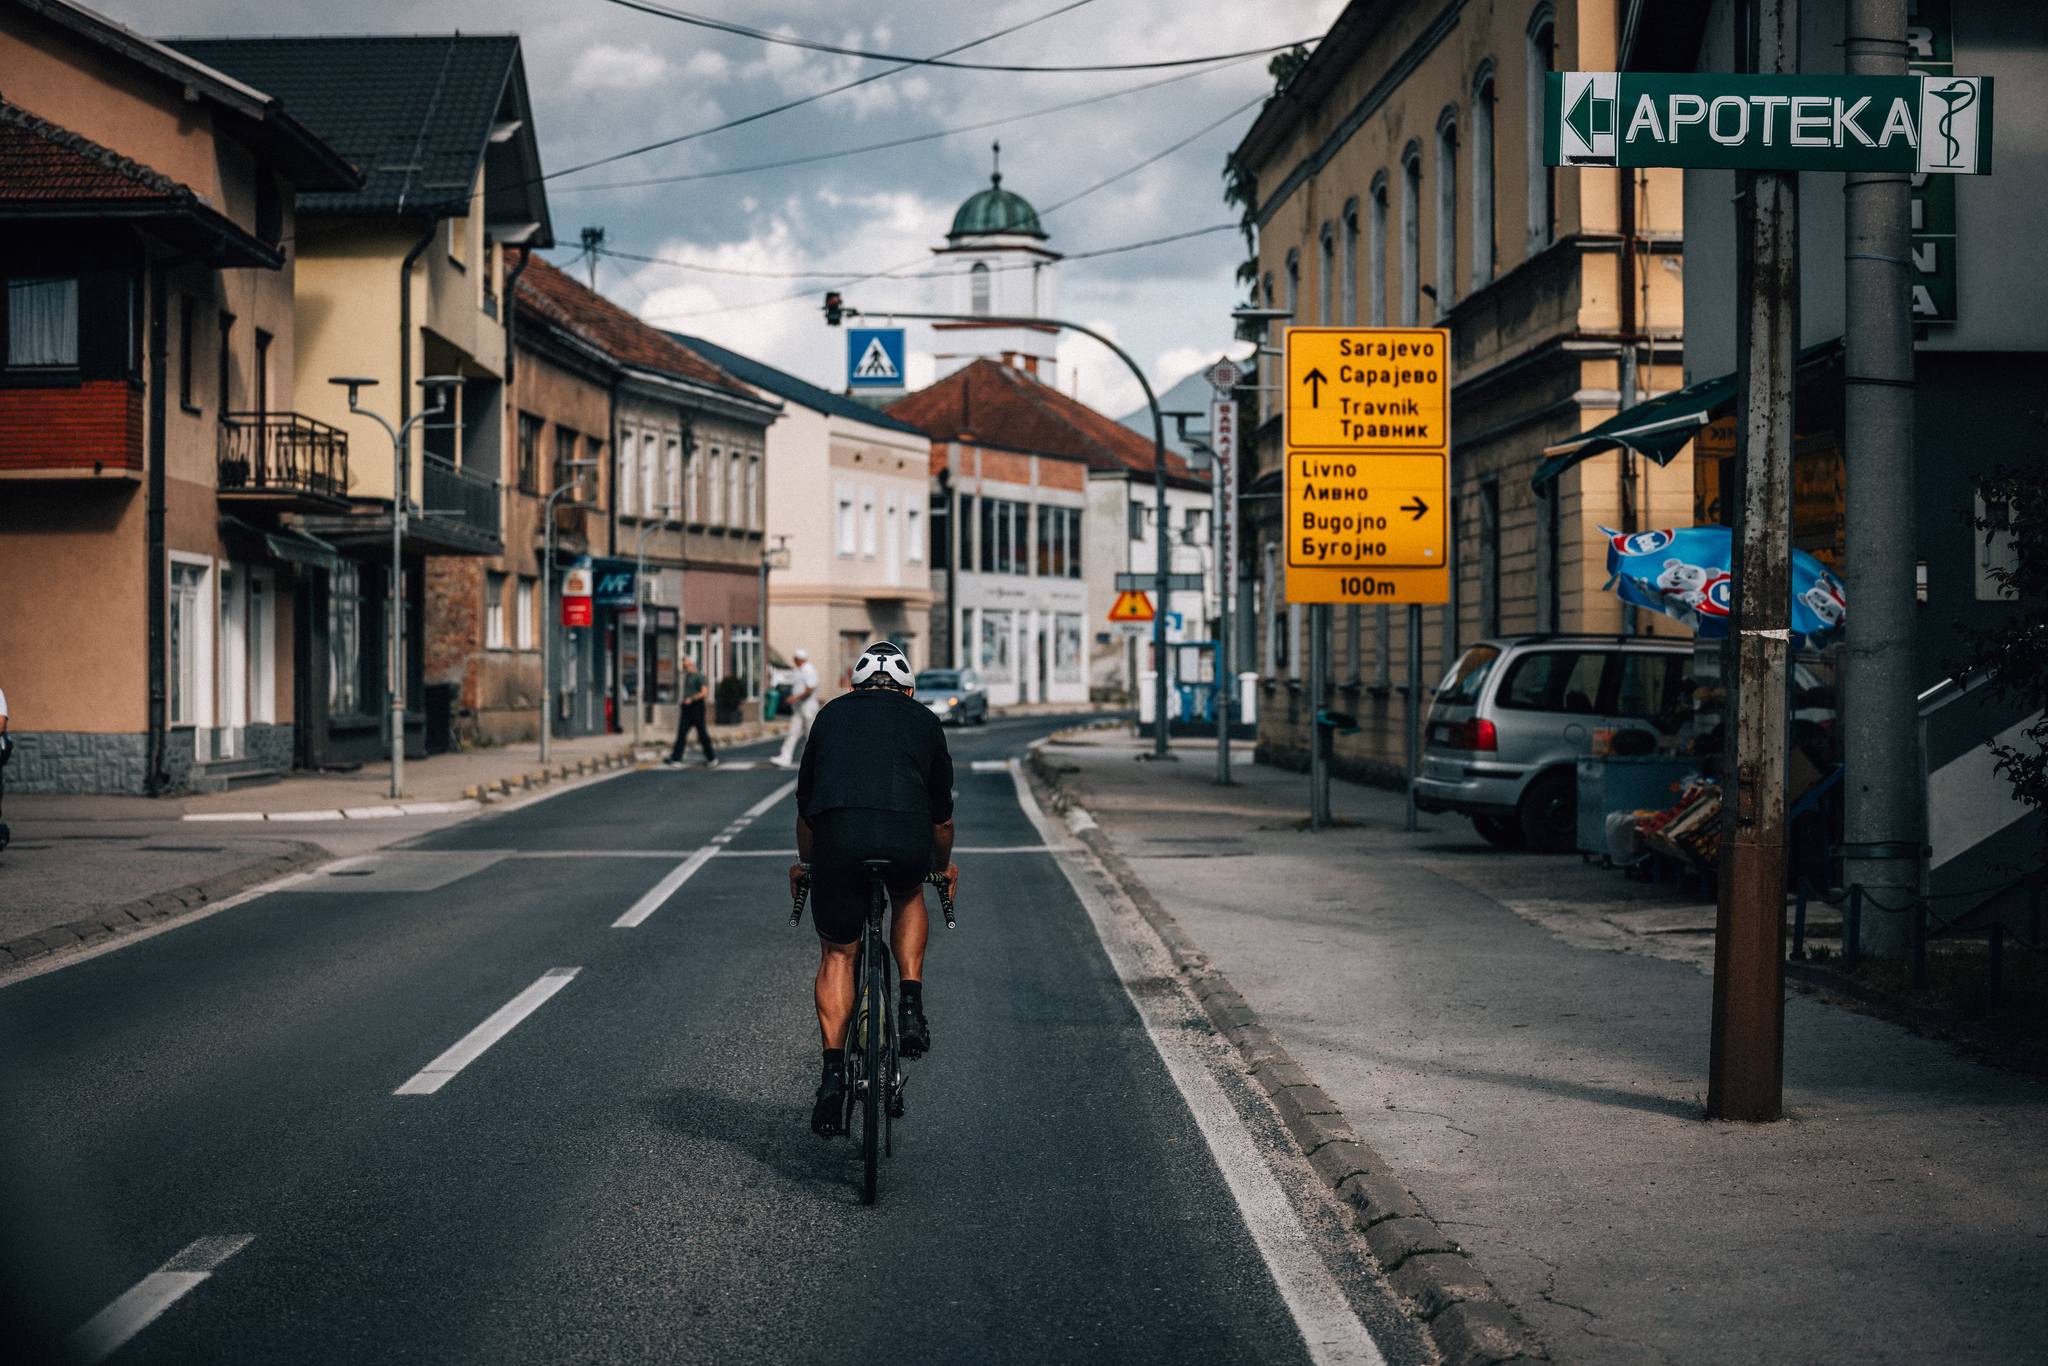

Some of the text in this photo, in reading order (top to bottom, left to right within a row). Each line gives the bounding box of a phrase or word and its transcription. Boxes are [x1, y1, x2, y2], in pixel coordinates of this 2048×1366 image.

[1625, 93, 1919, 148] APOTEKA
[1340, 338, 1434, 361] Sarajevo
[1340, 365, 1437, 388] Сарајево
[1340, 397, 1419, 415] Travnik
[1340, 419, 1428, 441] Травник
[1302, 460, 1357, 477] Livno
[1303, 483, 1368, 500] Ливно
[1303, 512, 1387, 534] Bugojno
[1302, 537, 1387, 560] Бугојно
[1341, 576, 1395, 596] 100m
